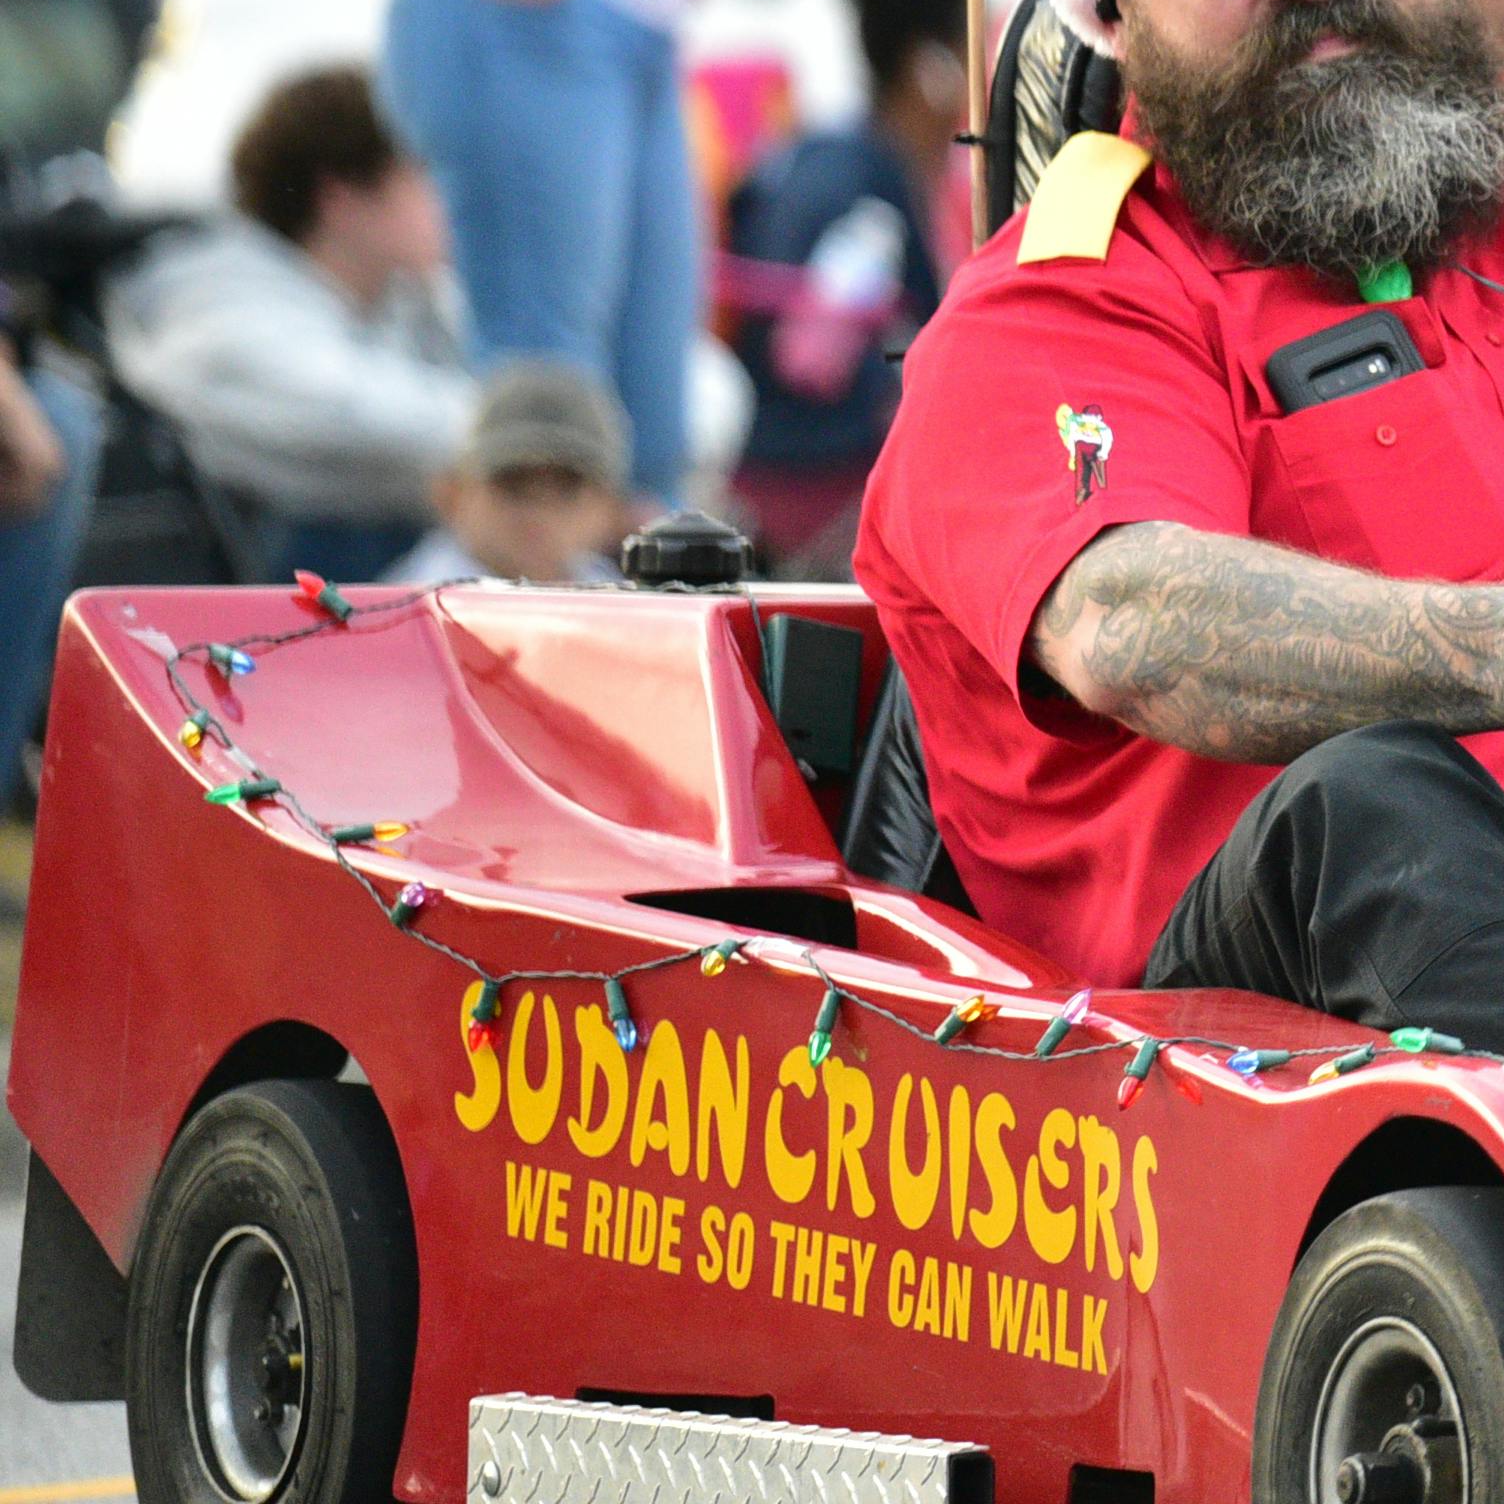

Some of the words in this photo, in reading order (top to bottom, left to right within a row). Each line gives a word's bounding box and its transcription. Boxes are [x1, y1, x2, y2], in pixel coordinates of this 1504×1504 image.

[454, 980, 750, 1189] SUDAN
[765, 1043, 1159, 1293] CRUISERS
[506, 1162, 572, 1248] WE
[583, 1179, 686, 1275] RIDE
[697, 1204, 755, 1291] SO
[770, 1220, 877, 1317] THEY
[889, 1249, 972, 1342] CAN
[987, 1272, 1109, 1376] WALK
